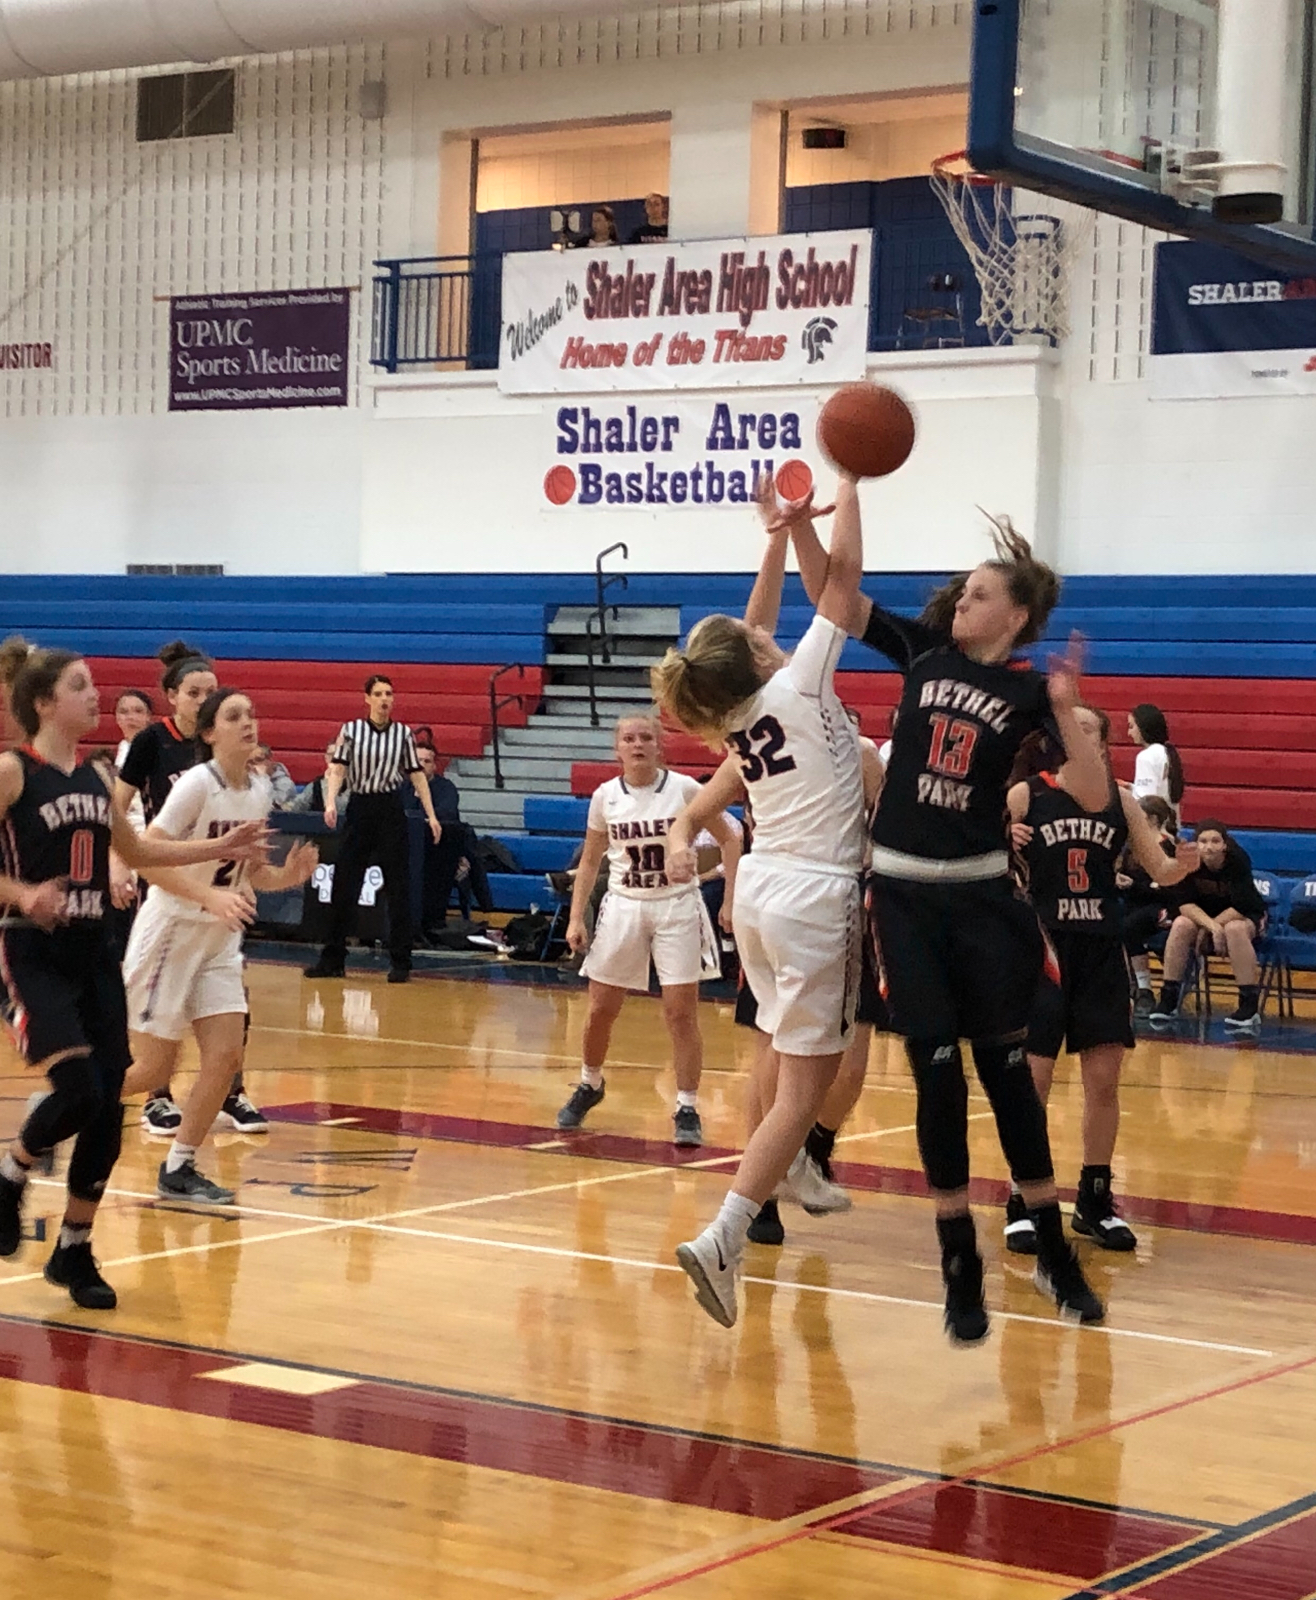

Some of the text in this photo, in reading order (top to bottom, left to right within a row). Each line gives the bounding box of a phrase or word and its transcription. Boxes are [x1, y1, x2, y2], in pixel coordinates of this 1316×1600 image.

[506, 244, 859, 361] Welcome to Shaler Area High School
[1188, 281, 1284, 305] SHALER
[176, 318, 254, 348] UPMC
[560, 329, 788, 369] Home of the Titans
[176, 347, 343, 385] Sports Medicine
[557, 403, 802, 454] Shaler Area
[919, 678, 1015, 734] BETHEL
[725, 714, 797, 783] 32
[927, 712, 979, 779] 13
[39, 792, 113, 831] BETHE
[917, 773, 974, 812] PARK
[1040, 818, 1116, 850] BETHEL
[70, 829, 94, 881] 0
[625, 843, 665, 872] 10
[1068, 847, 1089, 893] 5
[66, 888, 104, 919] ARK
[1057, 898, 1104, 921] PARK
